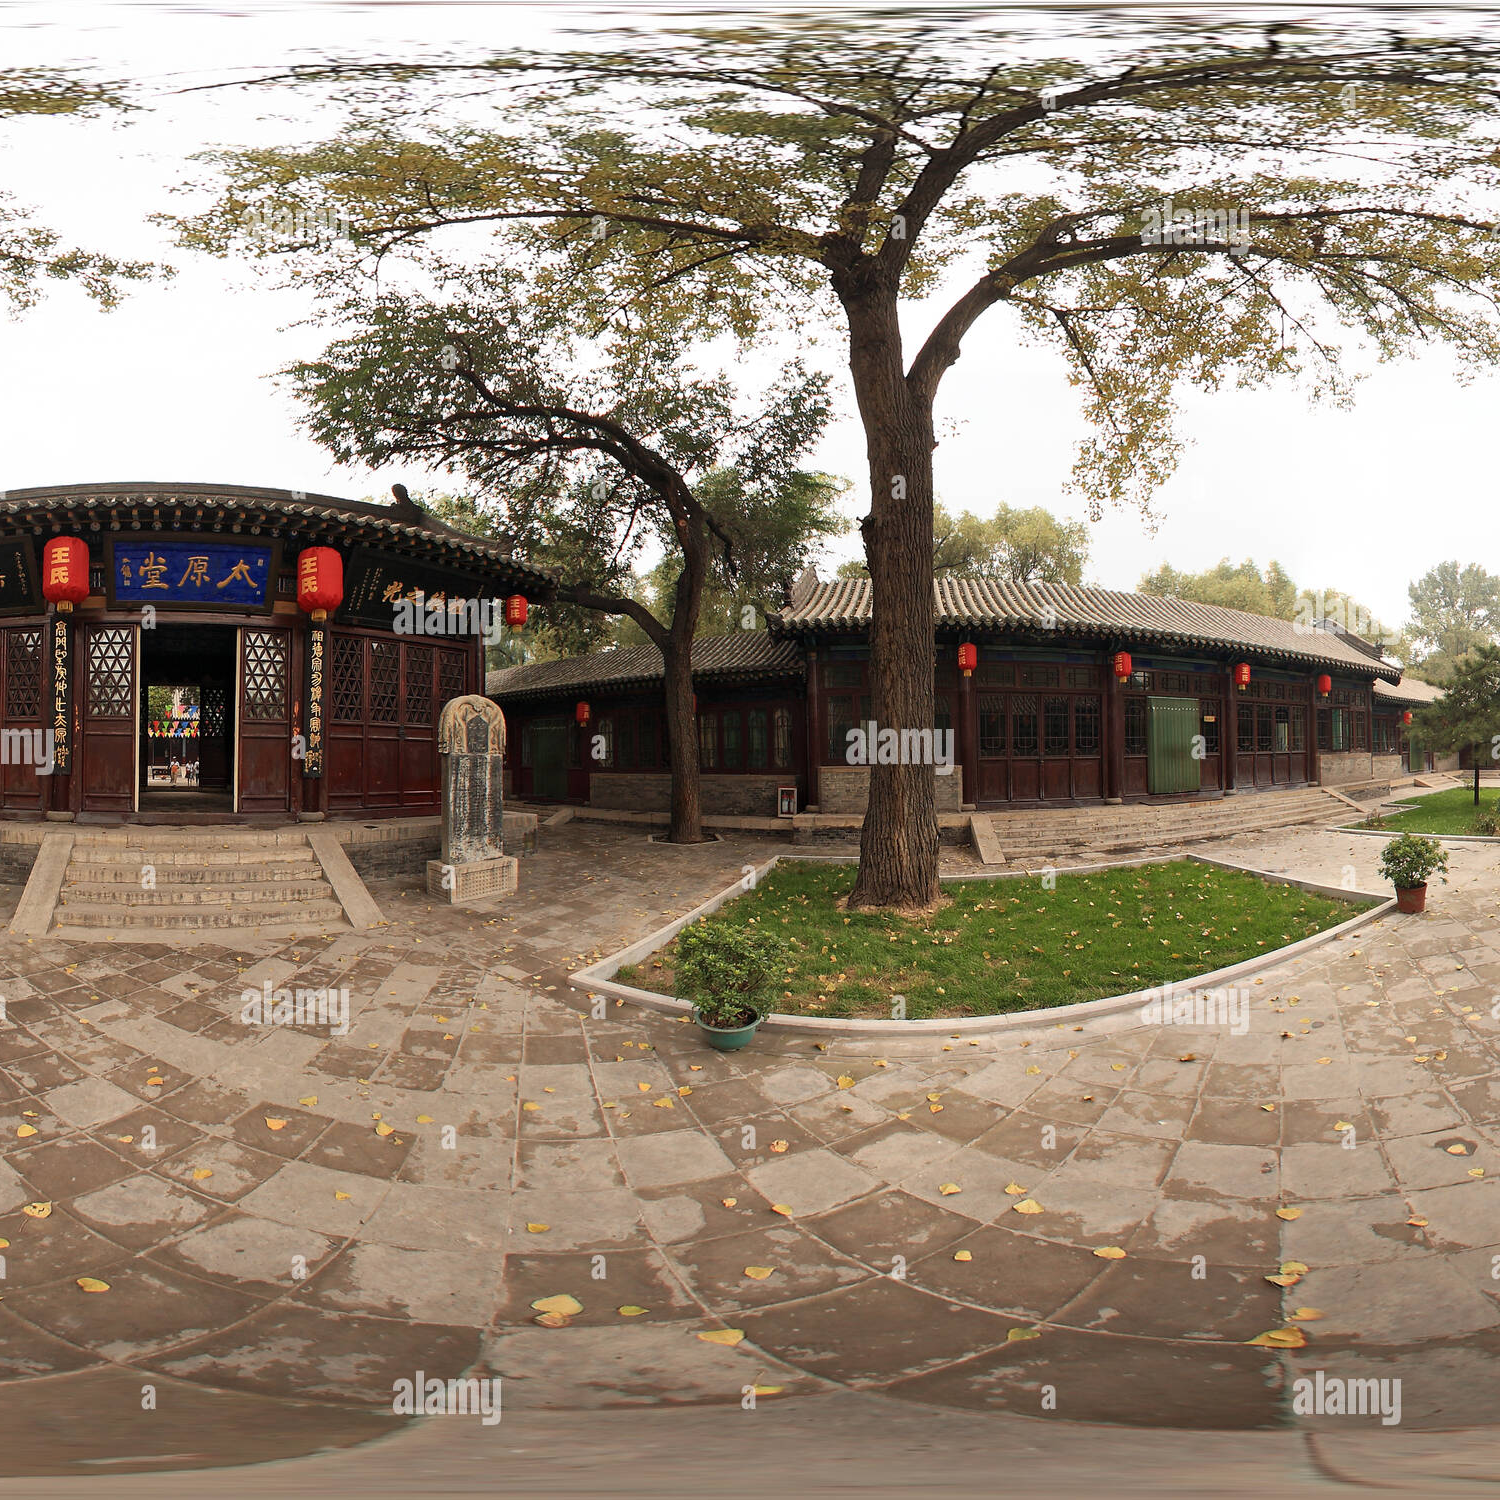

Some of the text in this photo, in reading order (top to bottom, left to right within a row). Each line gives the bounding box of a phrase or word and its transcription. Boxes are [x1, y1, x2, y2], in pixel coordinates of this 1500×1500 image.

[50, 547, 70, 584] 王氏
[138, 552, 258, 590] 太原堂
[301, 557, 318, 594] 王氏
[510, 599, 521, 619] 王氏
